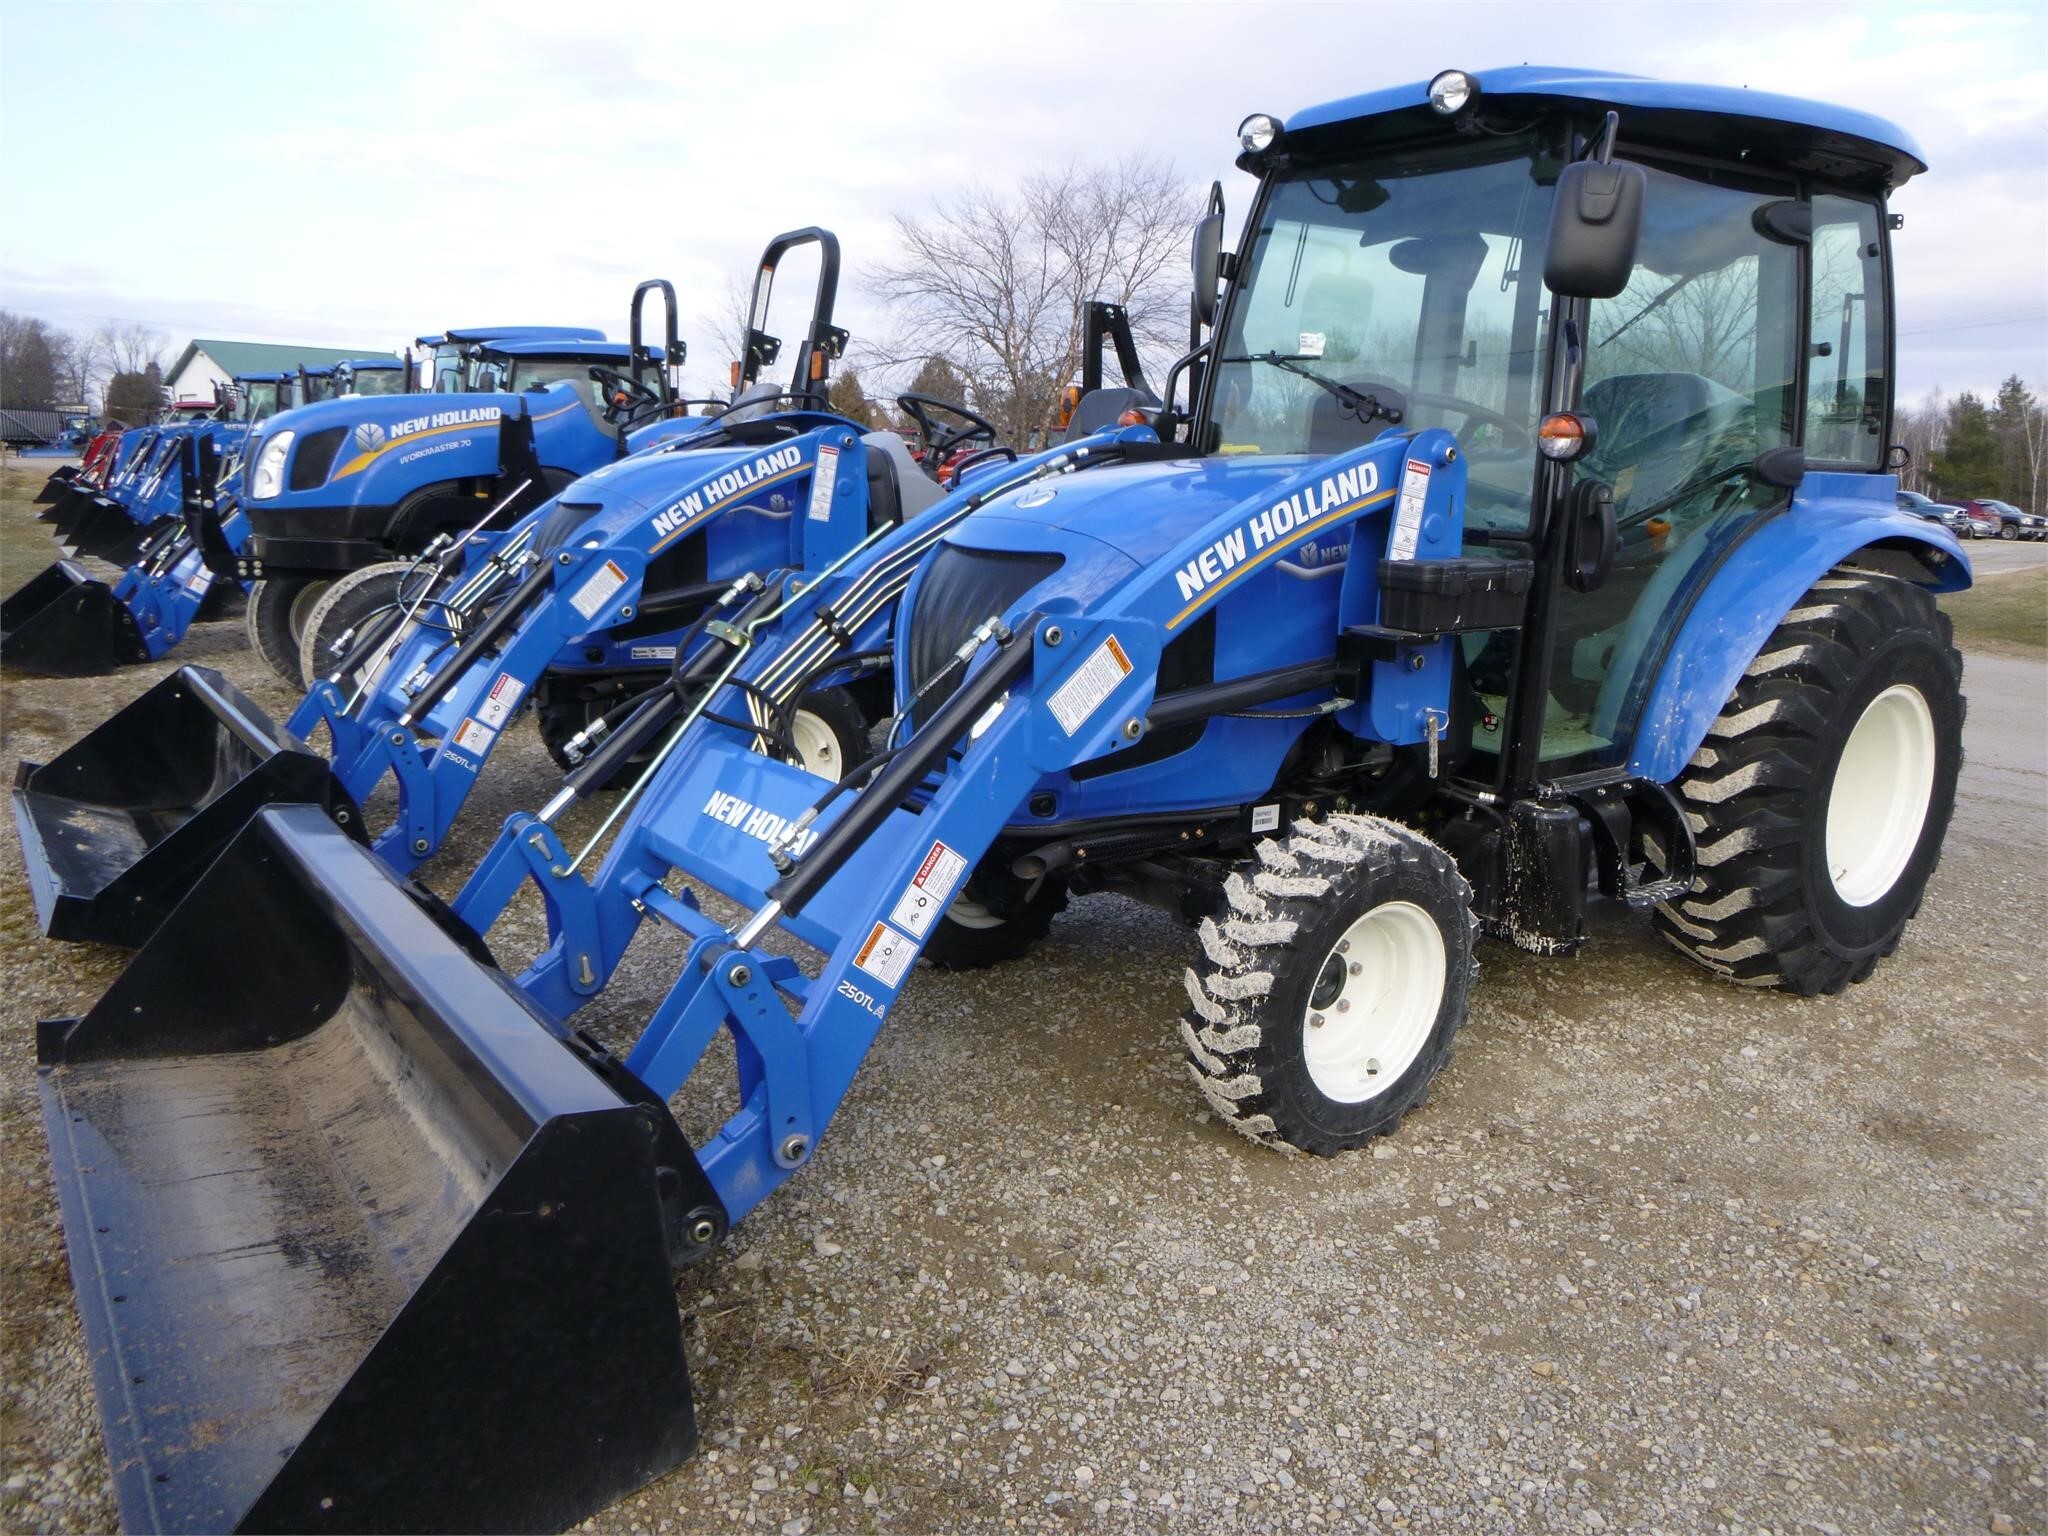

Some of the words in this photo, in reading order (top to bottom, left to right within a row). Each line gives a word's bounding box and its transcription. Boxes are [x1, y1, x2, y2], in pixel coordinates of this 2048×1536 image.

[390, 416, 430, 438] NEW
[431, 407, 501, 428] HOLLAND
[400, 441, 459, 464] WORKMASTER
[460, 439, 471, 448] 70
[651, 491, 704, 537] NEW
[703, 446, 800, 504] HOLLAND
[1175, 528, 1247, 601] NEW
[1249, 462, 1378, 550] HOLLAND
[702, 790, 753, 828] NEW
[921, 847, 941, 876] DANGER
